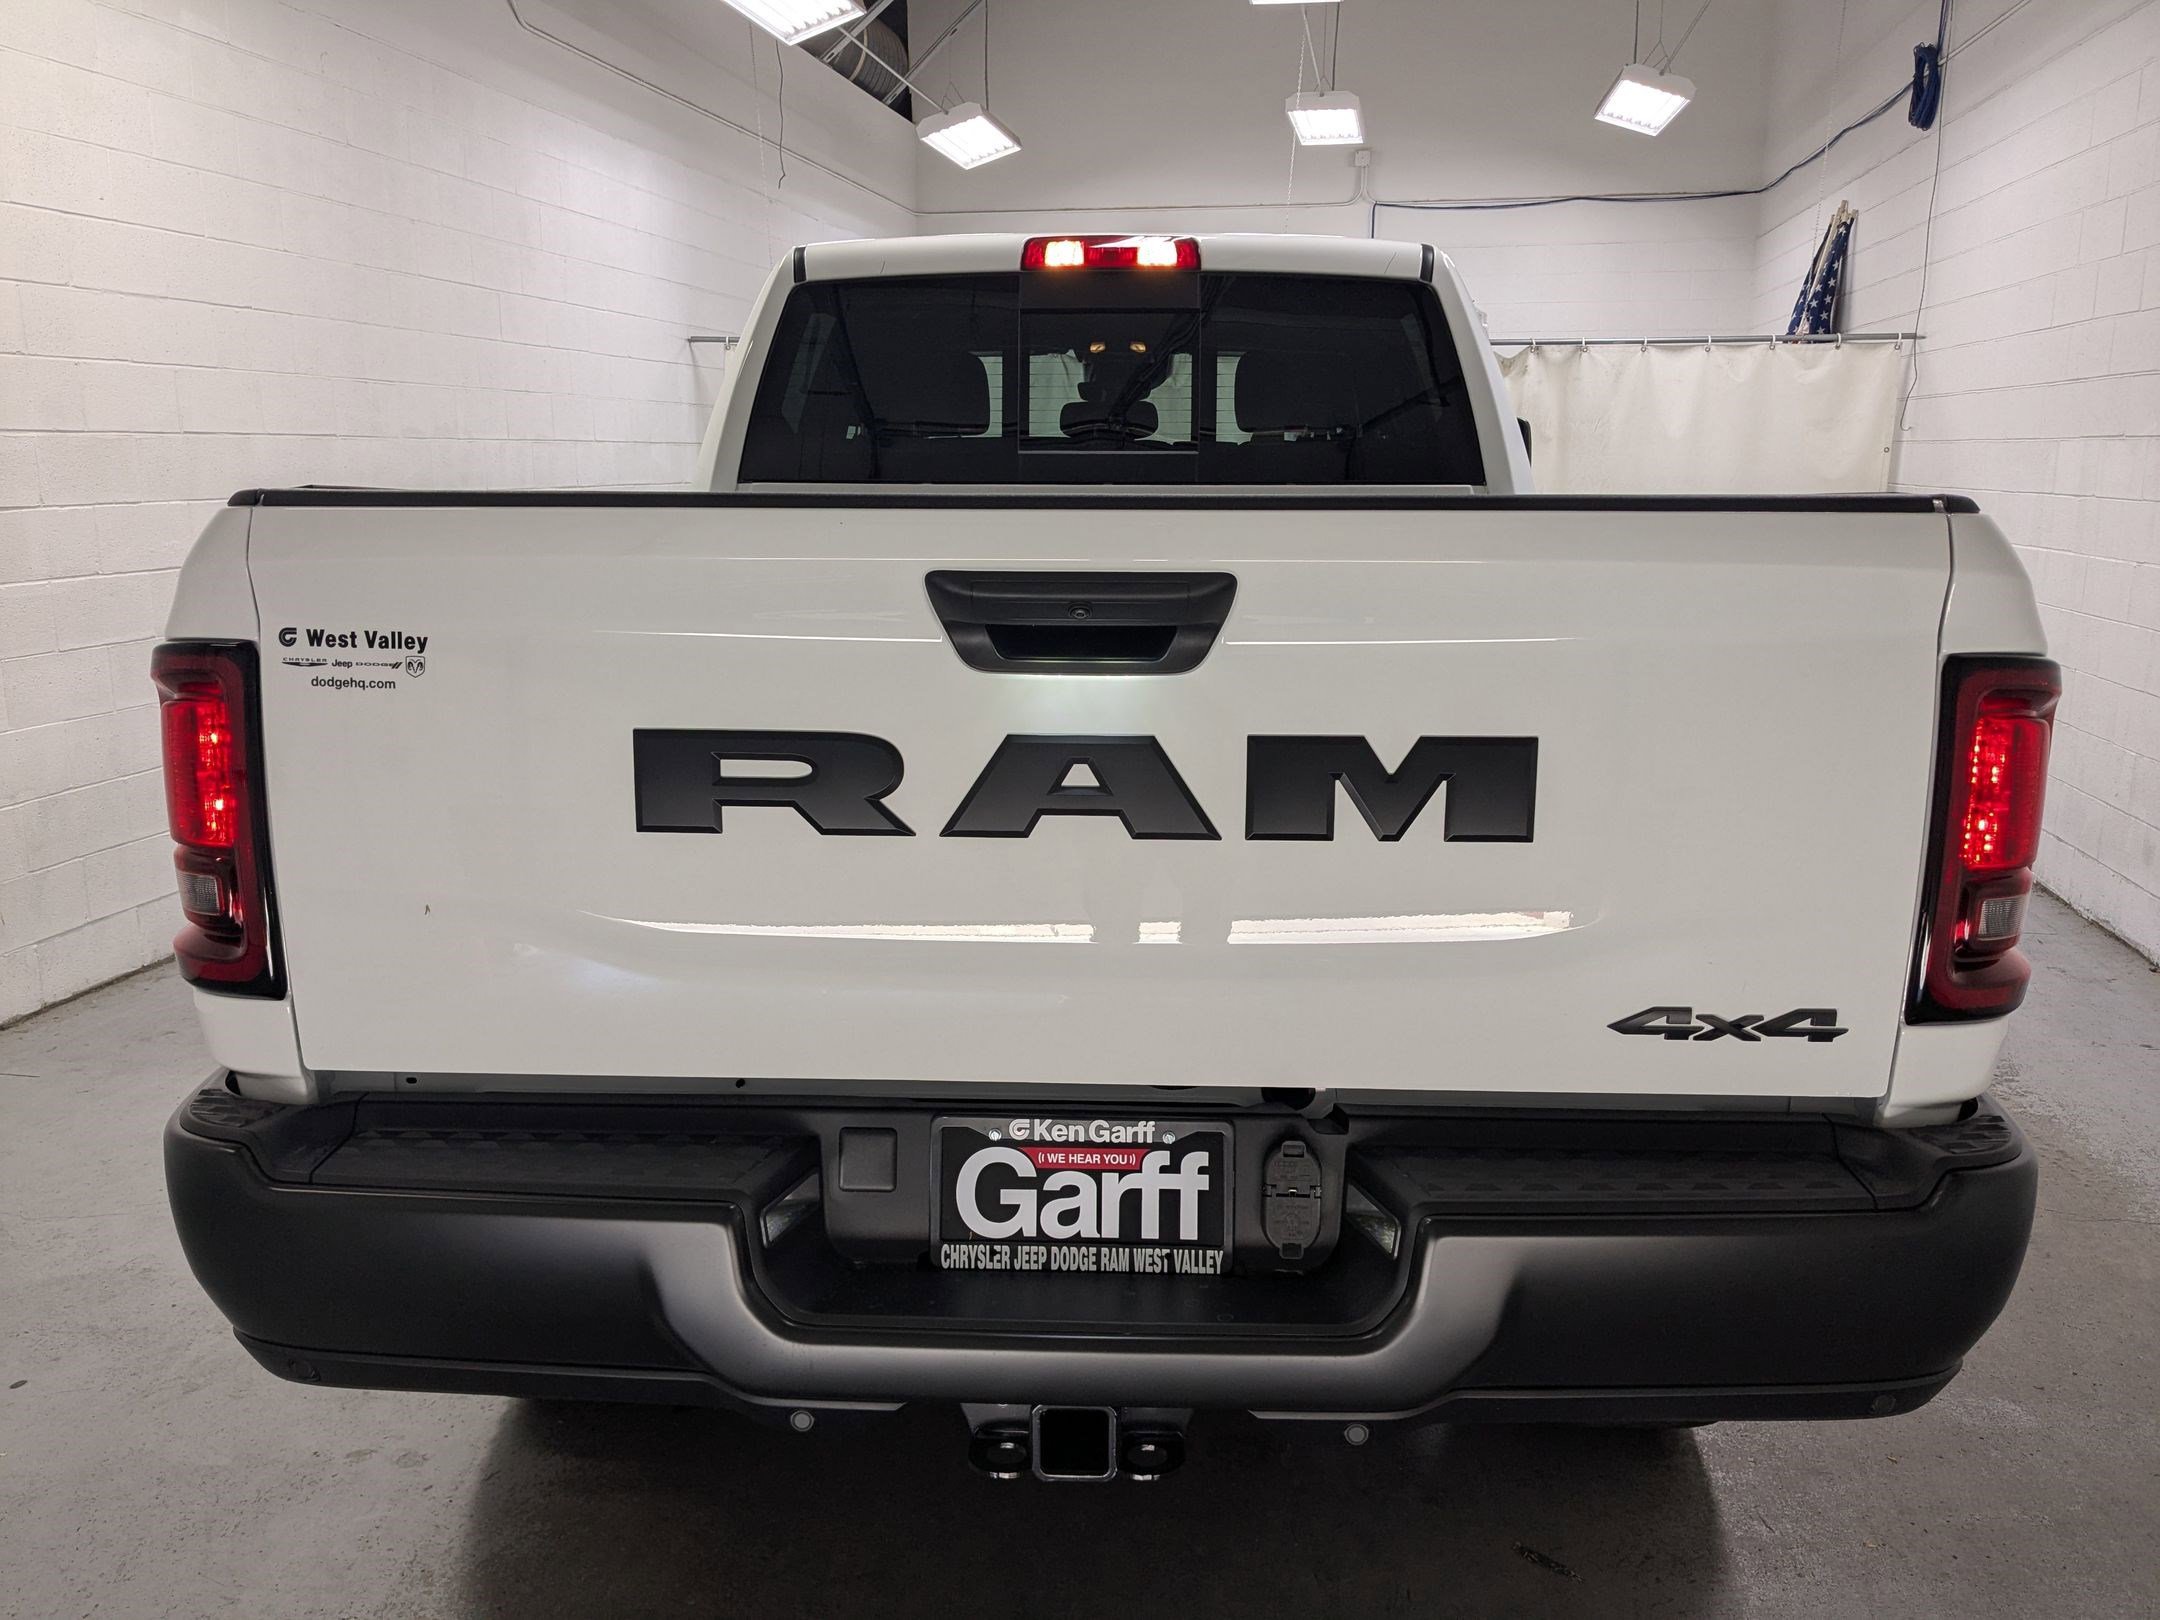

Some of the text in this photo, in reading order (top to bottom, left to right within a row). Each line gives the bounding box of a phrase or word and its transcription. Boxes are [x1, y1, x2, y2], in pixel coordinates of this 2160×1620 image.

[306, 629, 358, 648] West
[364, 630, 428, 654] Valley
[331, 659, 353, 669] Jeep
[311, 676, 396, 690] dodgehq.com
[633, 728, 1539, 842] RAM
[1606, 1006, 1849, 1042] 4x4
[1033, 1119, 1085, 1142] Ken
[1088, 1120, 1156, 1143] Garff
[1047, 1152, 1128, 1165] WE HEAR YOU
[955, 1146, 1210, 1241] Garff
[940, 1243, 1224, 1275] CHRYSLER JEEP DODGE RAM WEST VALLEY
